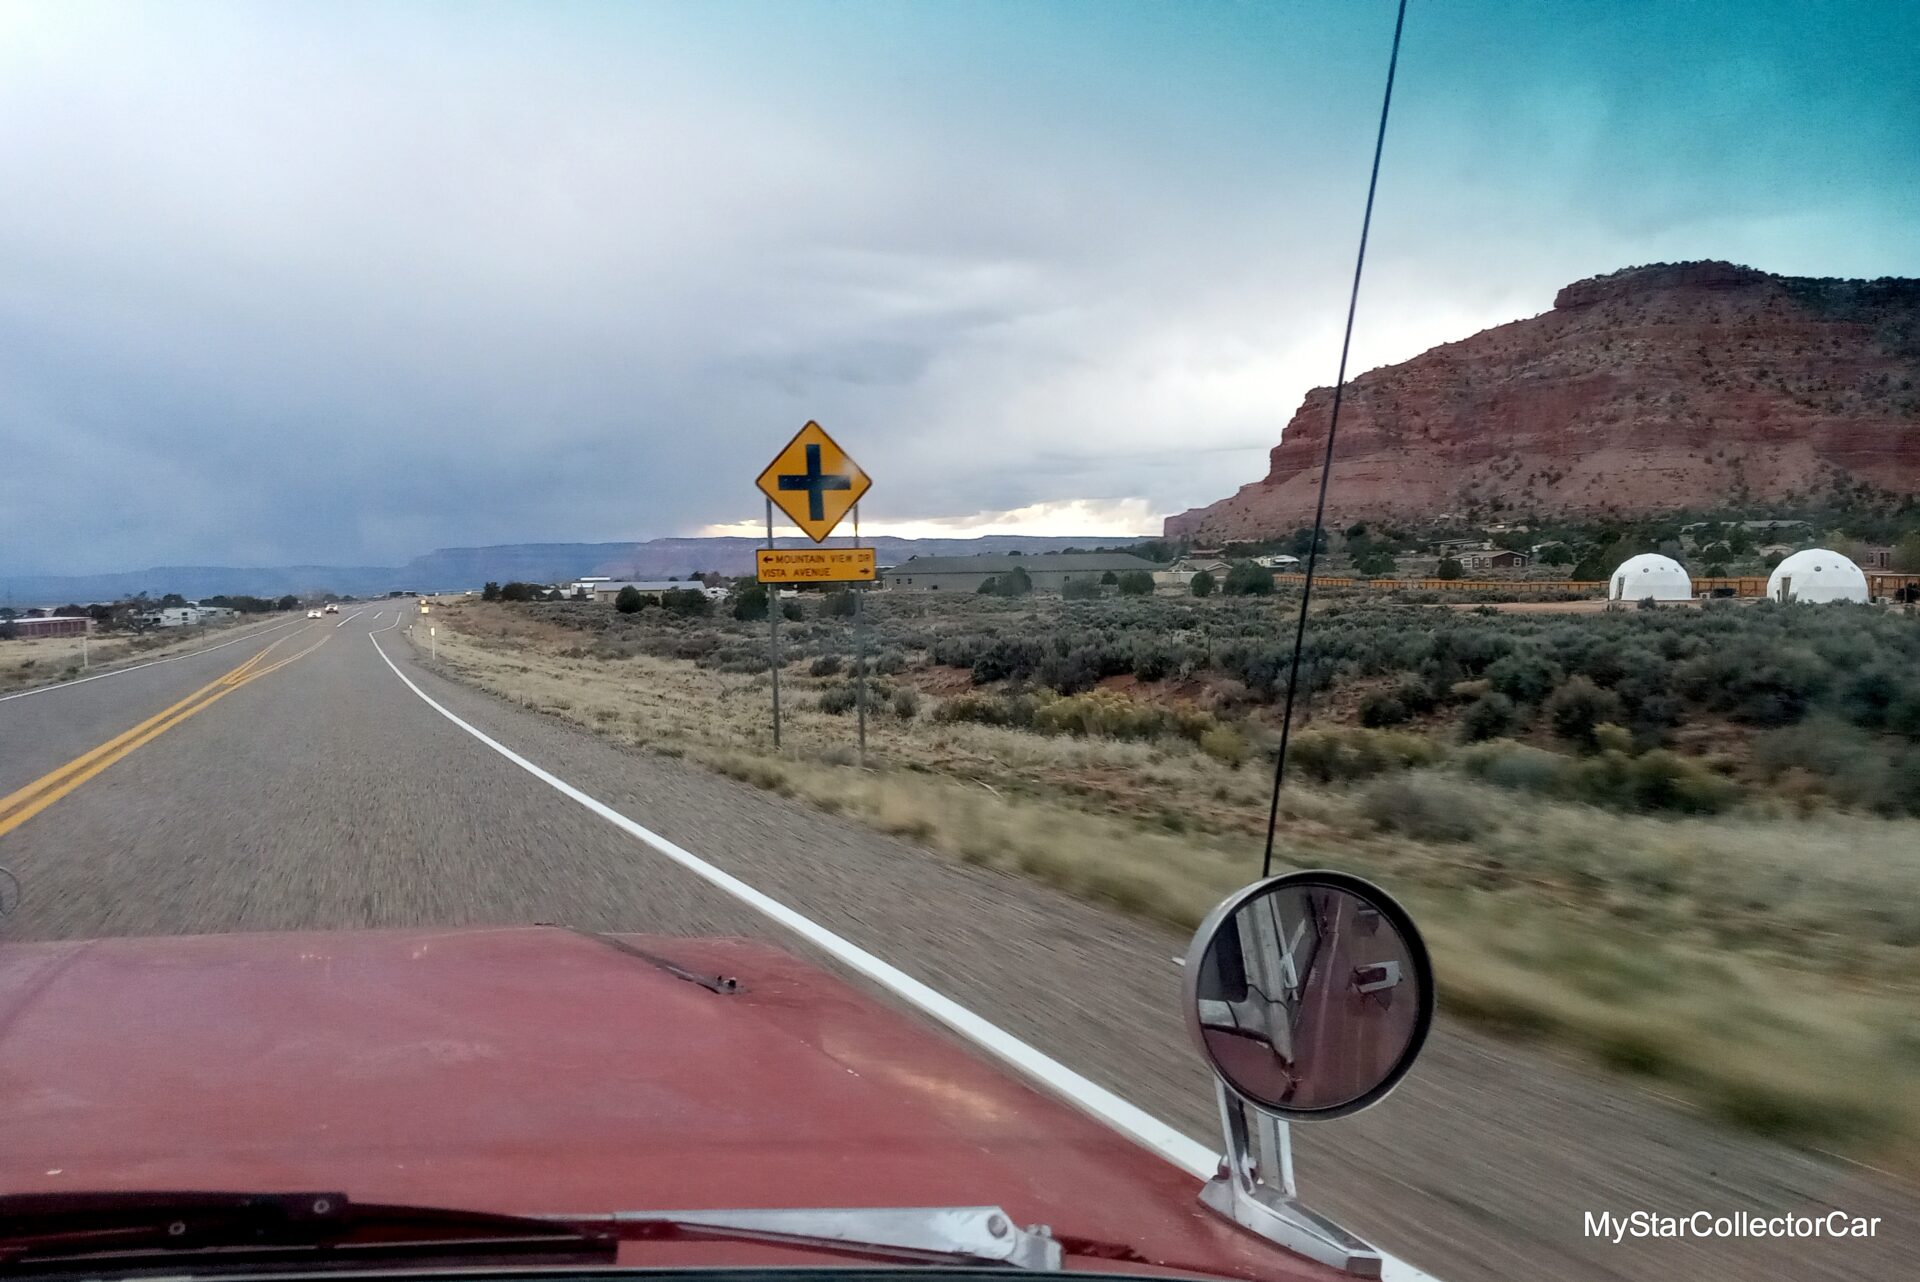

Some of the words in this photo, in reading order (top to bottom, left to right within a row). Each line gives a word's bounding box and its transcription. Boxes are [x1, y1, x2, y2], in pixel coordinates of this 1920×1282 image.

[775, 554, 825, 564] MOUNTAIN
[831, 554, 853, 563] VIEW
[858, 553, 871, 563] DR
[761, 568, 786, 577] VISTA
[793, 567, 831, 577] AVENUE
